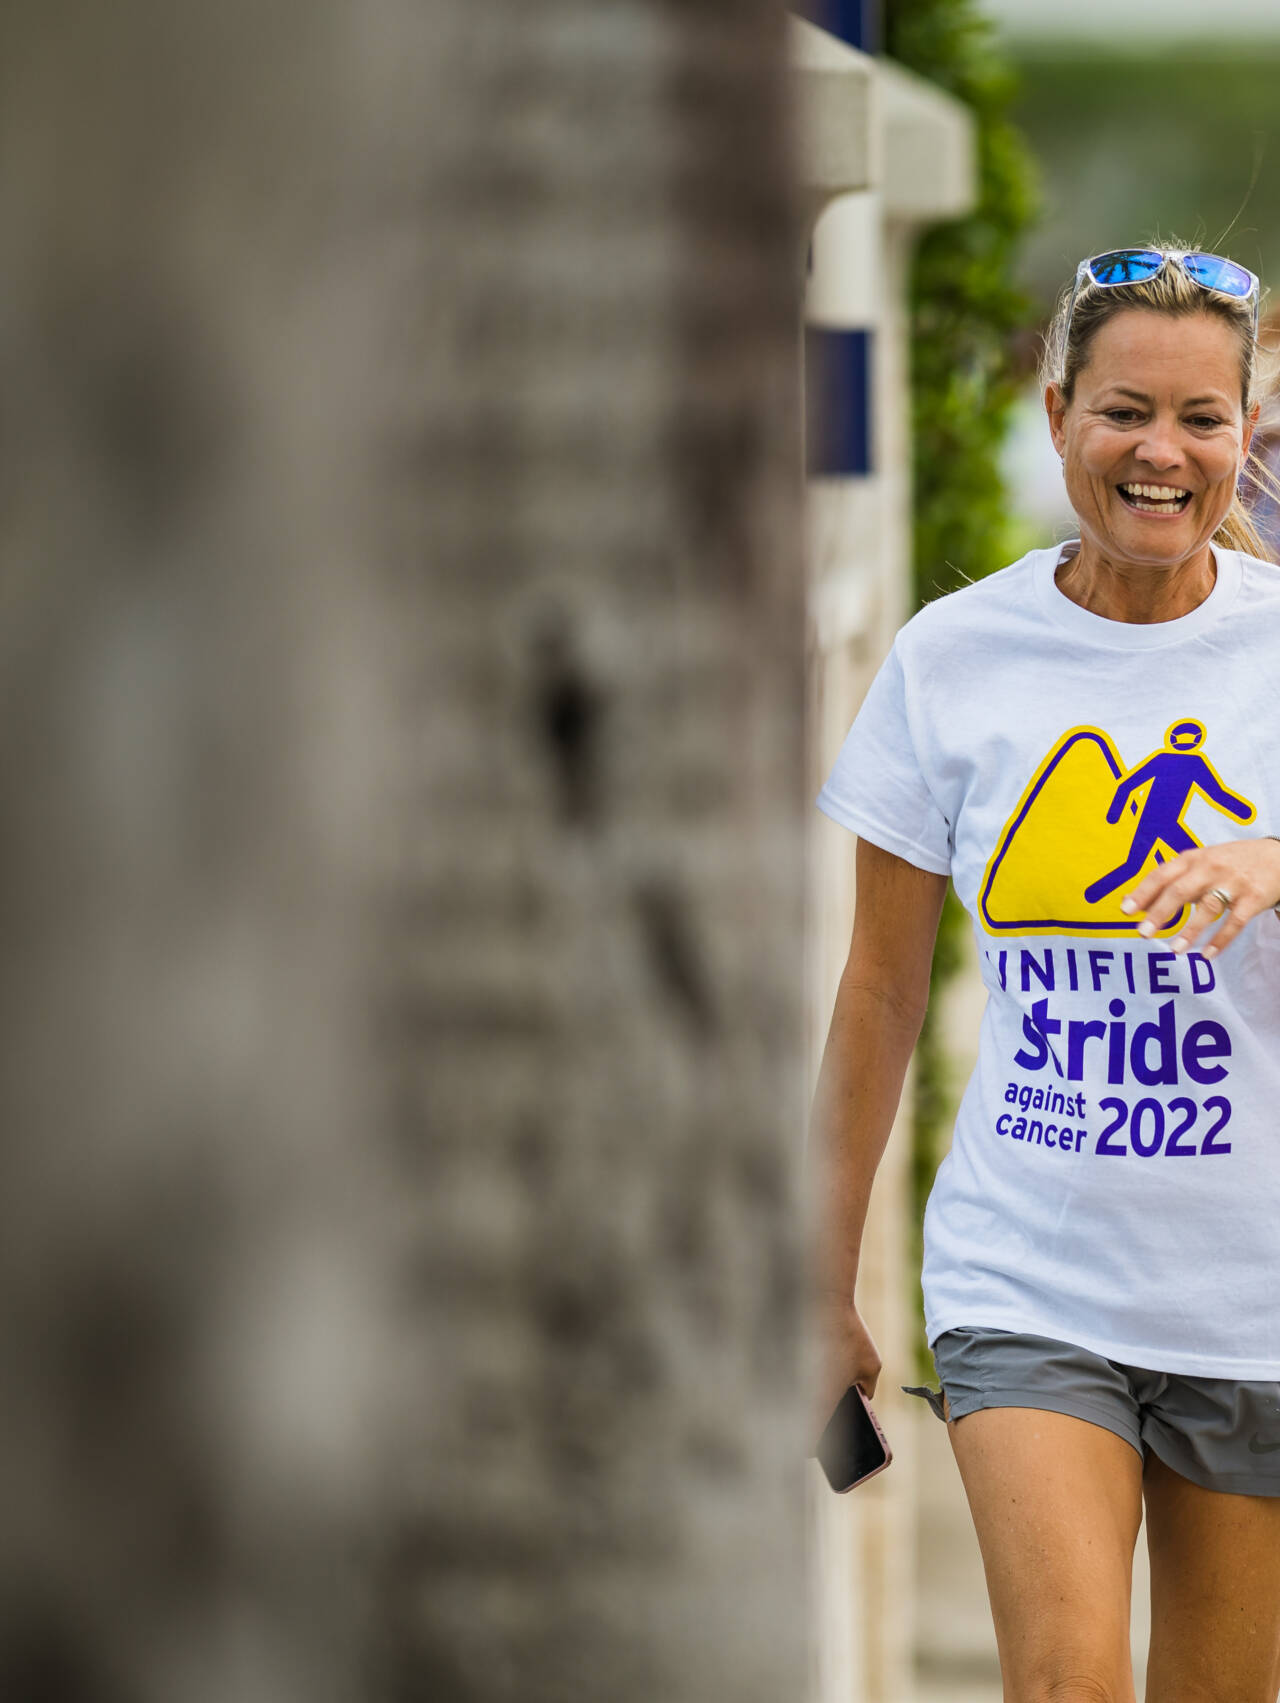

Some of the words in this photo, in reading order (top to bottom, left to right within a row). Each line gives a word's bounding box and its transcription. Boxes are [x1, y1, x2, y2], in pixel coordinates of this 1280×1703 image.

[1004, 1082, 1086, 1119] against
[996, 1113, 1087, 1152] cancer
[1095, 1096, 1232, 1157] 2022
